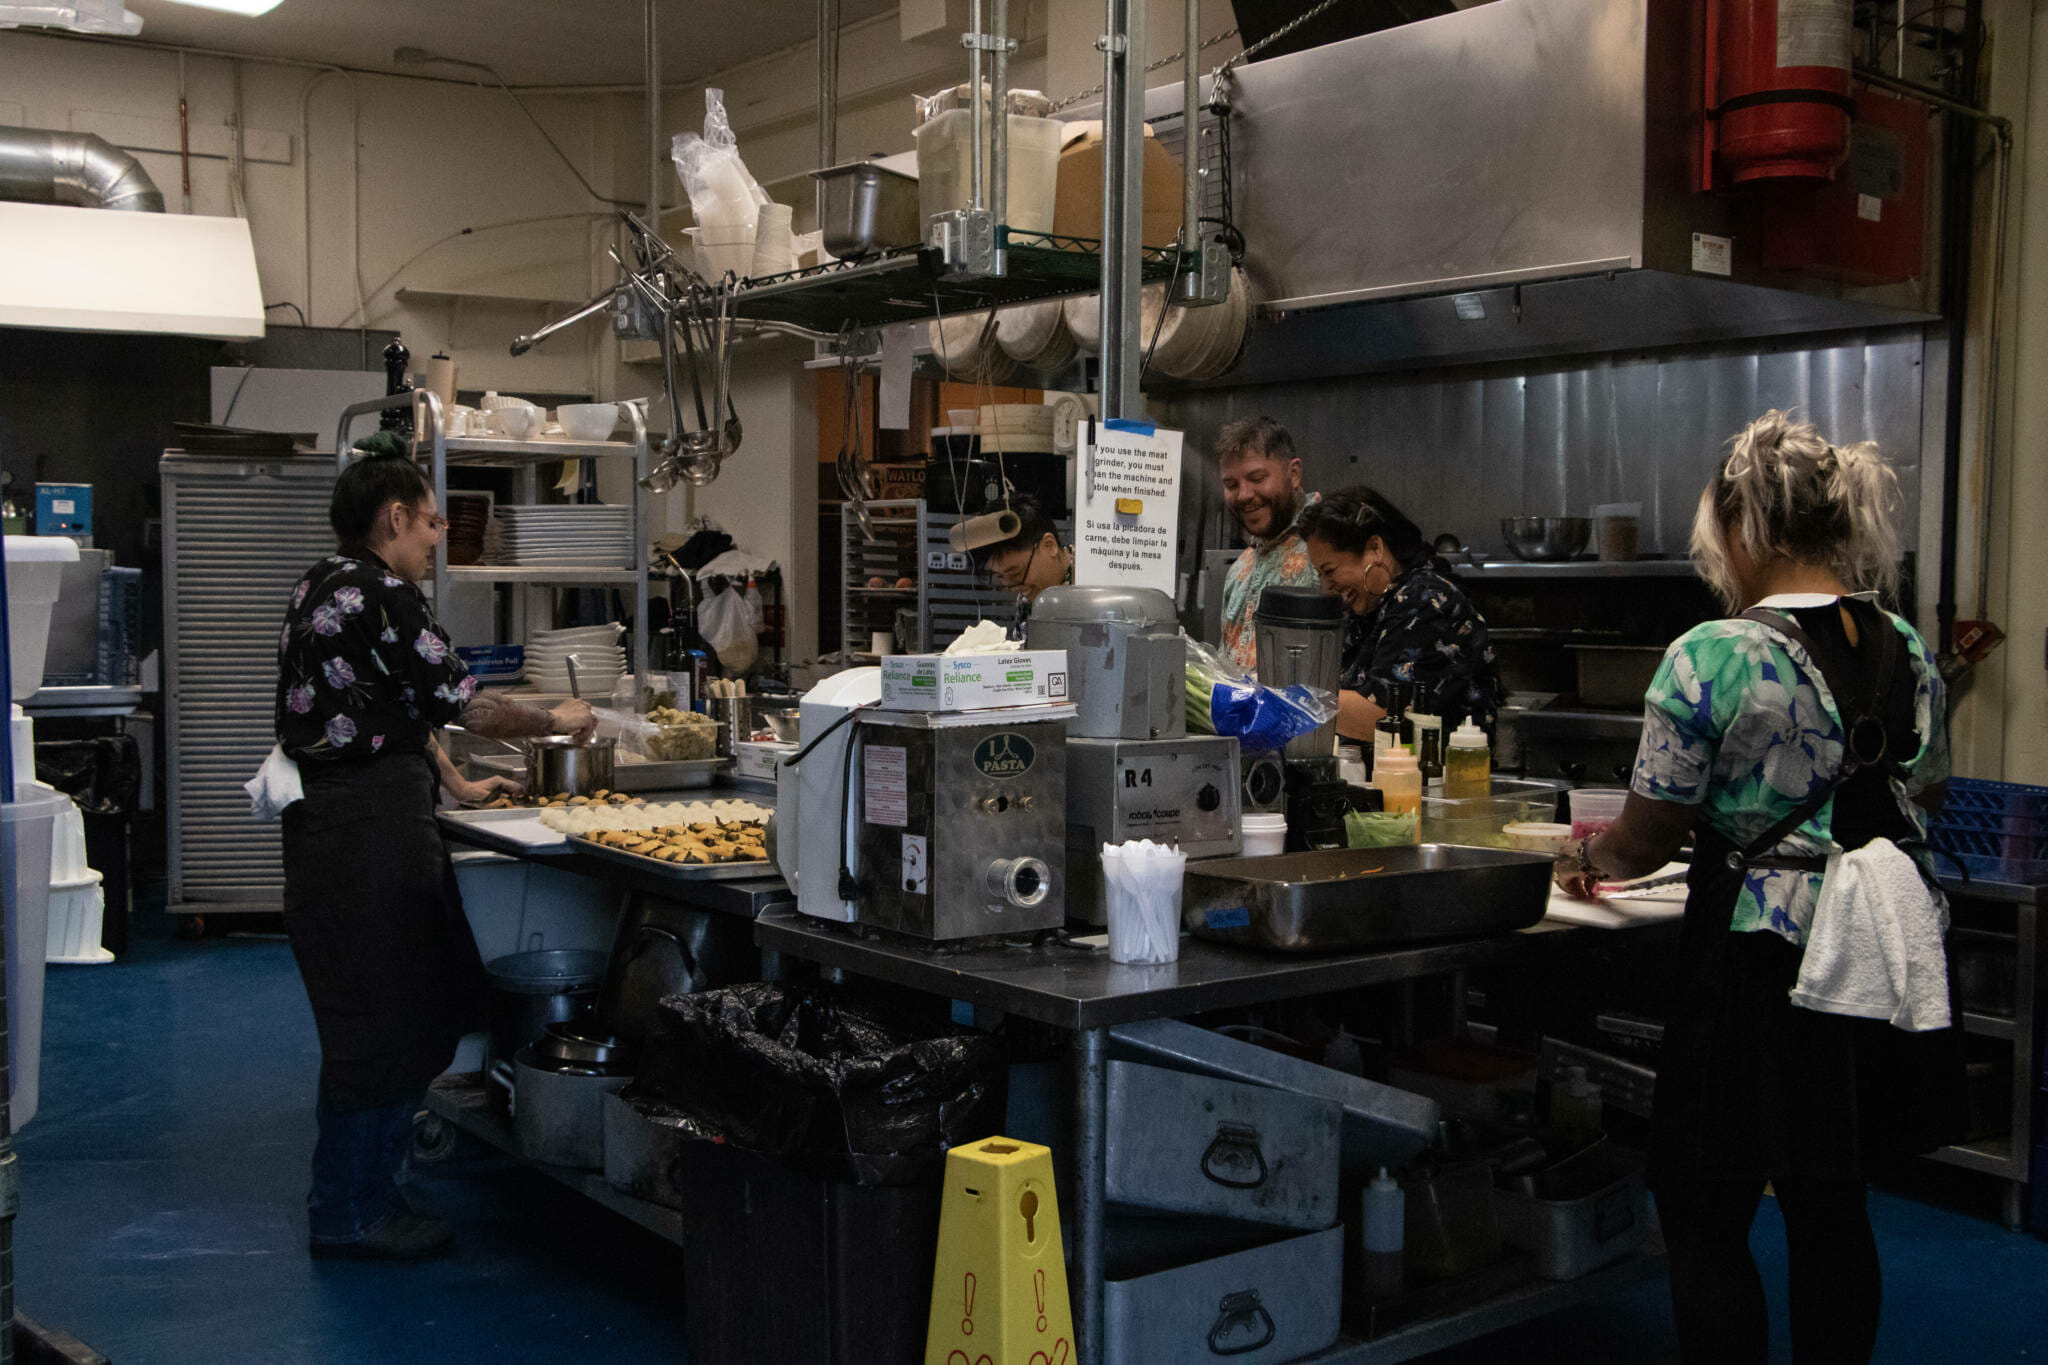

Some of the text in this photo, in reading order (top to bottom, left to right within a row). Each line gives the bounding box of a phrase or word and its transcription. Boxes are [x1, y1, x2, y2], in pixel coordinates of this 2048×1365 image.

[1100, 446, 1115, 455] you
[1117, 447, 1132, 456] use
[1134, 448, 1147, 457] the
[1148, 450, 1168, 460] meat
[1128, 461, 1143, 470] you
[1144, 462, 1165, 472] must
[1108, 471, 1122, 480] the
[1123, 474, 1157, 484] machine
[1158, 476, 1173, 486] and
[1111, 485, 1132, 494] when
[1134, 486, 1168, 498] finished.
[1086, 520, 1167, 535] Si usa la picadora de
[1084, 534, 1168, 548] carne, debe limpiar la
[1090, 546, 1162, 560] máquina y la mesa
[952, 660, 972, 671] Sysco
[883, 670, 911, 681] Reliance
[944, 672, 983, 684] Reliance
[983, 760, 1026, 772] PASTA
[1125, 768, 1153, 788] R 4
